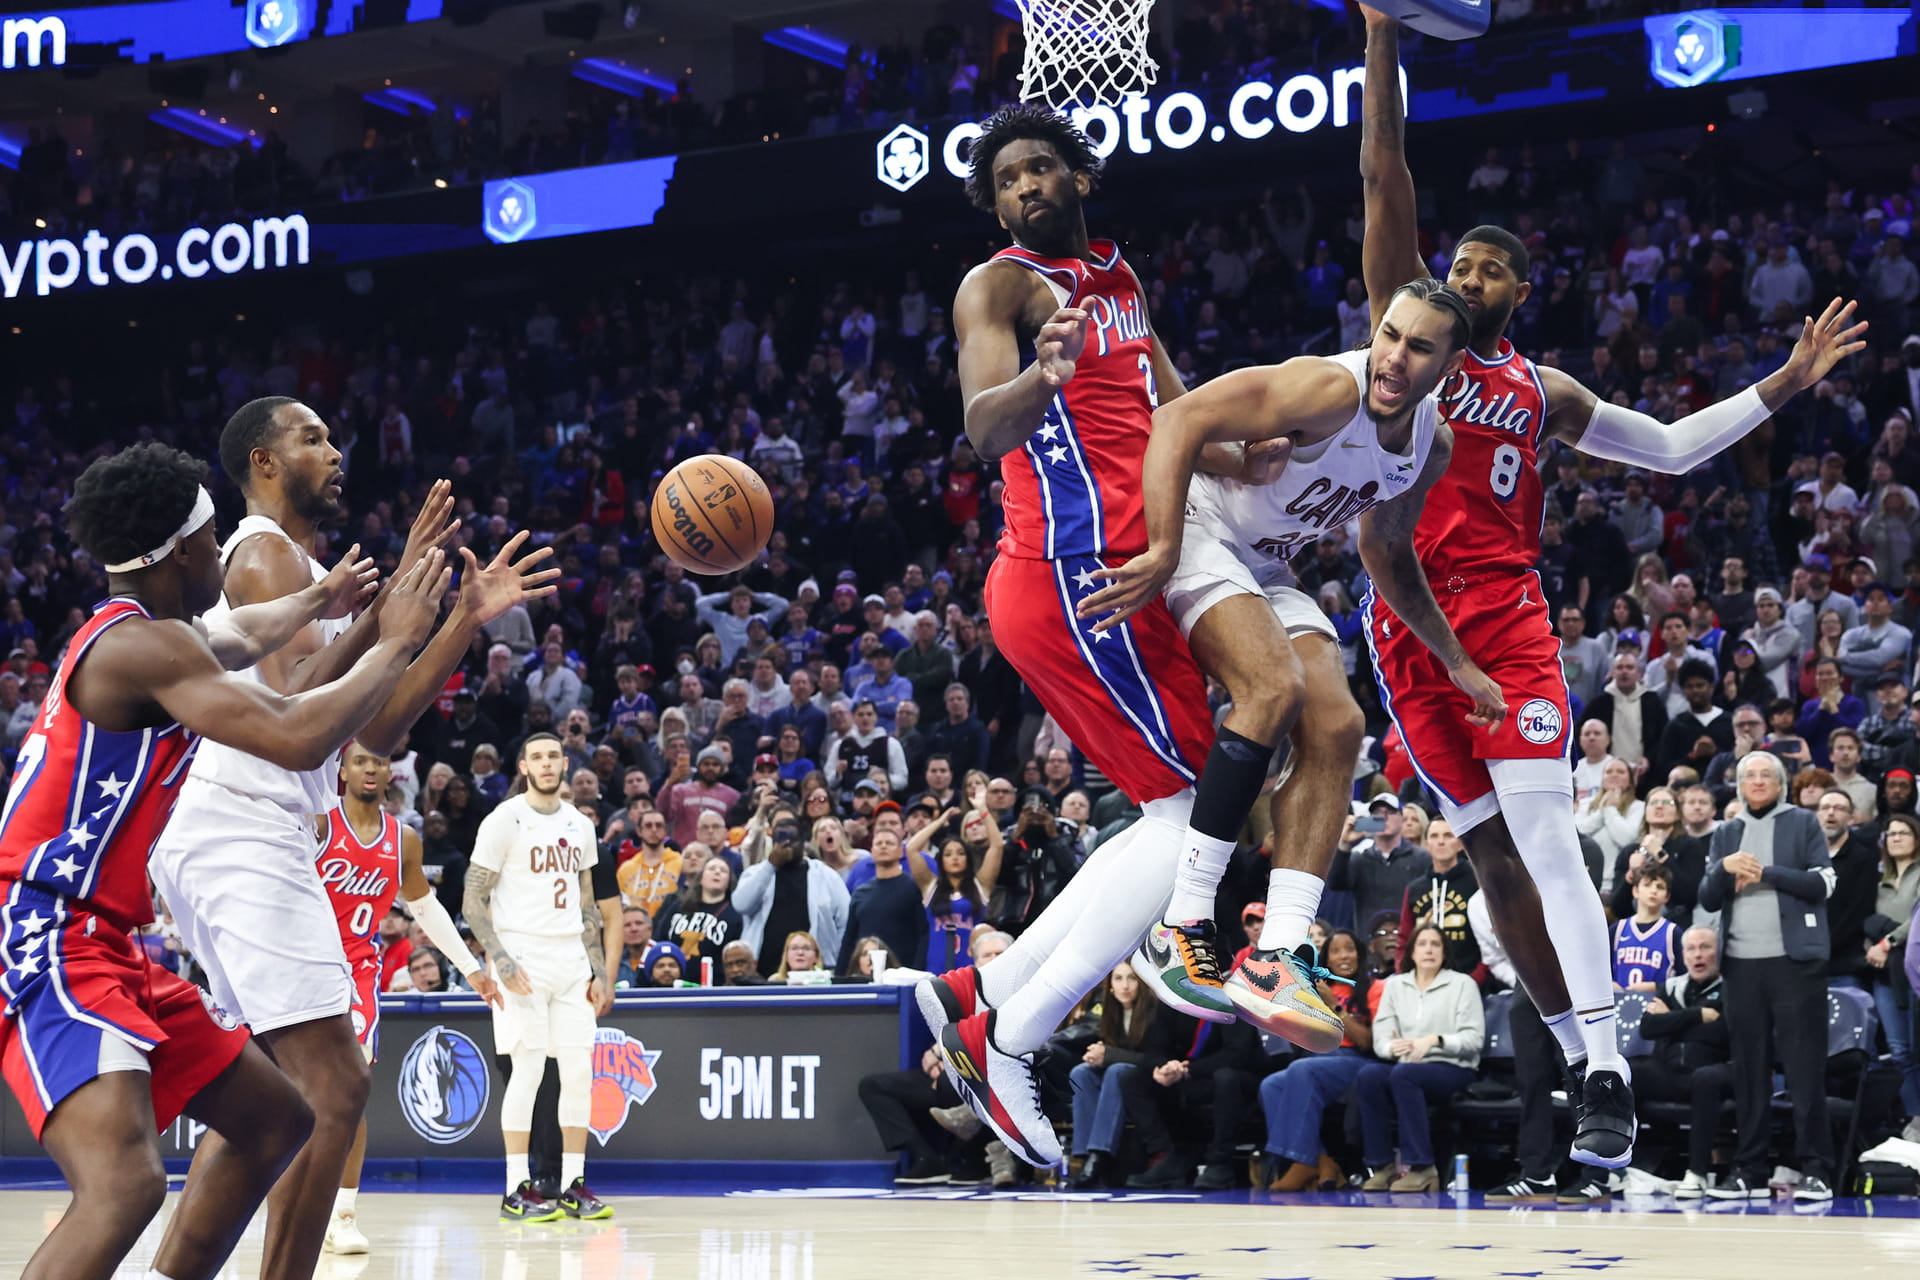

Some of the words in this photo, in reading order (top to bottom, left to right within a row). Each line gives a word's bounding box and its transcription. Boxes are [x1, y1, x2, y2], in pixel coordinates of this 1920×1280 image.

[943, 62, 1408, 178] cpto.com
[1088, 291, 1149, 357] Phil
[1429, 370, 1531, 434] Phila
[1386, 473, 1409, 485] CLIFFS
[1490, 444, 1521, 497] 8
[666, 483, 714, 557] Wilson
[1523, 715, 1557, 733] 76ers
[852, 755, 869, 770] 25
[321, 858, 389, 897] Phila
[530, 845, 581, 874] CAVS
[554, 878, 567, 909] 2
[1413, 888, 1467, 913] CLEAND
[350, 902, 374, 936] 0
[668, 911, 728, 946] 76ERS
[594, 1041, 653, 1088] ICKS
[699, 1048, 773, 1120] 5PM
[782, 1055, 820, 1120] ET
